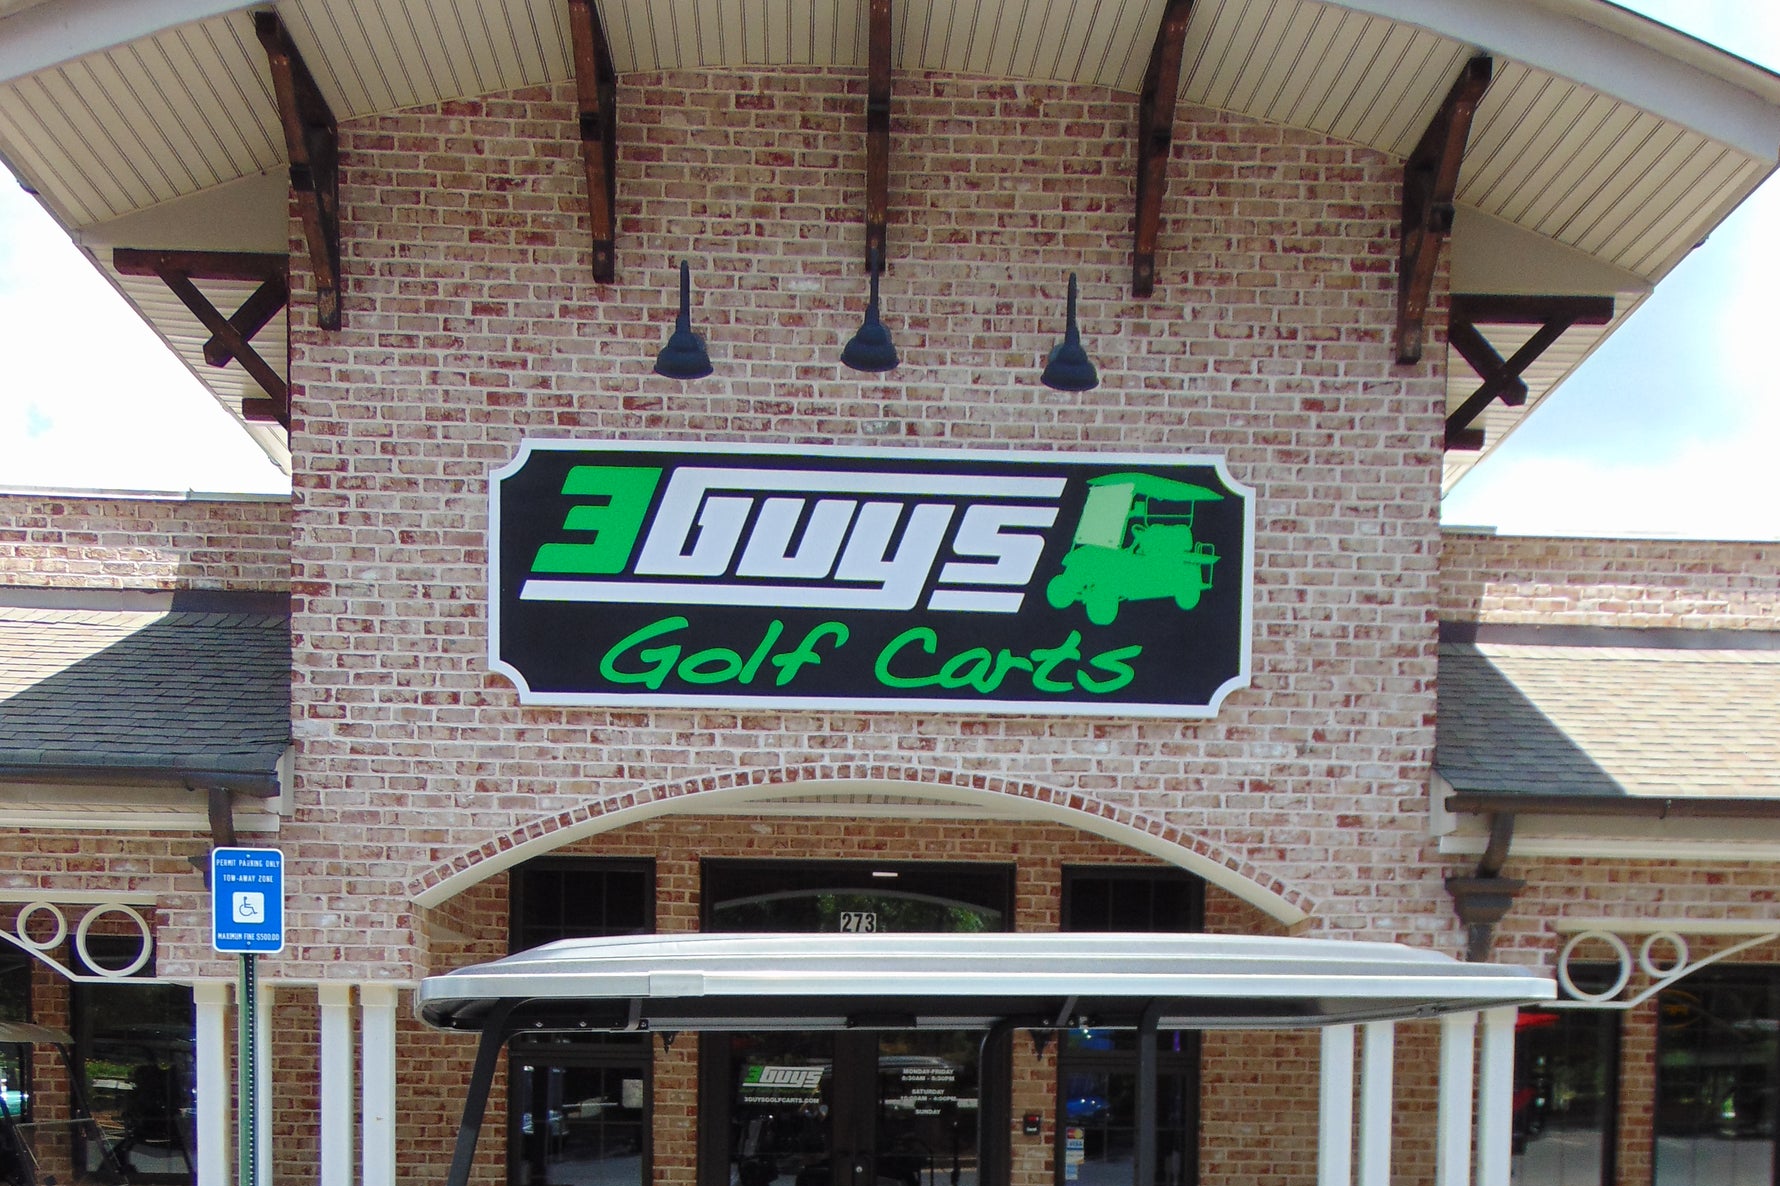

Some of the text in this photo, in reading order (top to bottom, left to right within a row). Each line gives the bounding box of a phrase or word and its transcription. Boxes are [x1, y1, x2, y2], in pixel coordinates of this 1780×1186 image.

[599, 616, 1143, 694] Golf Carts
[216, 859, 280, 868] PERMIT PARKING ONLY
[223, 874, 274, 883] TOW-AWAY ZONE
[842, 912, 875, 932] 273
[217, 932, 243, 940] MAXIMUM
